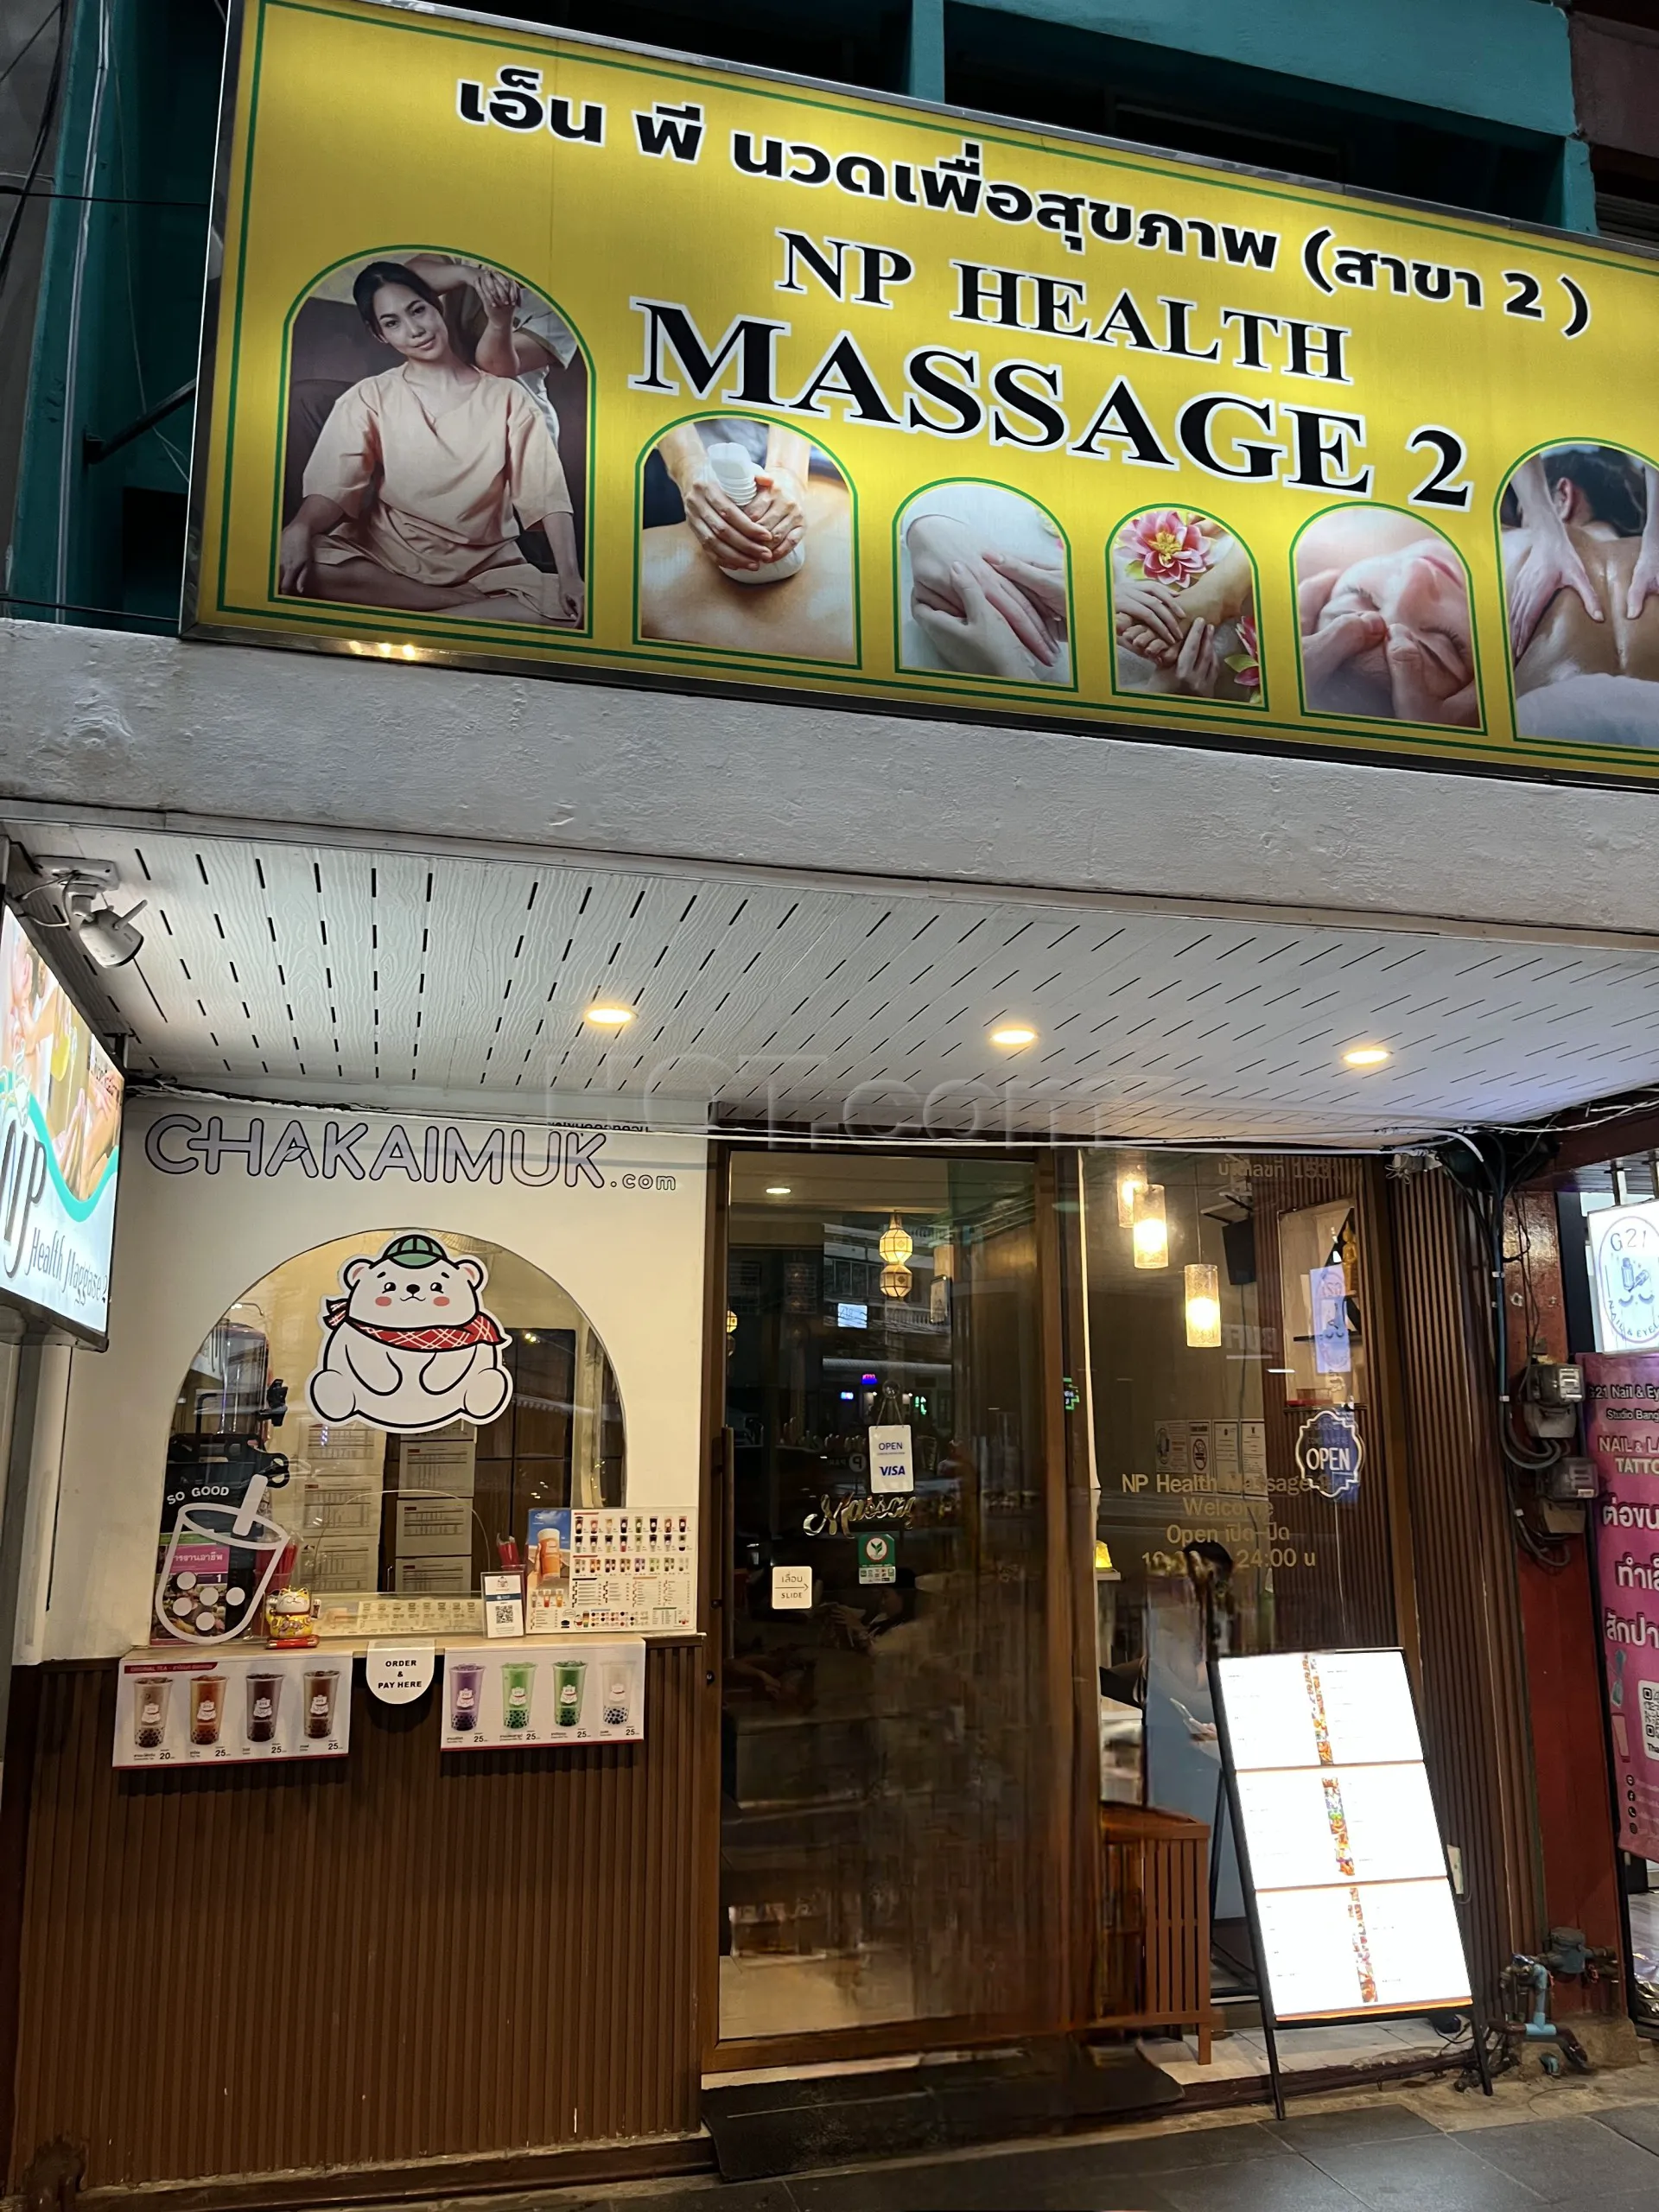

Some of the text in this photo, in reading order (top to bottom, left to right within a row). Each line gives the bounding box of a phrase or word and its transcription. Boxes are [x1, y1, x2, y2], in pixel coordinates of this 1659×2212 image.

[458, 67, 604, 144] เอ็น
[635, 104, 703, 162] พี
[732, 141, 1278, 269] นวดเพื่อสุขภาพ
[1304, 227, 1483, 308] (สาขา
[775, 228, 1352, 385] NP HEALTH
[629, 296, 1472, 512] MASSAGE 2
[1610, 1227, 1648, 1252] G21
[24, 1226, 66, 1281] Health
[1611, 1386, 1632, 1399] Nail
[1636, 1387, 1646, 1398] &
[878, 1441, 903, 1451] OPEN
[1599, 1438, 1631, 1452] NAIL
[1636, 1444, 1643, 1452] &
[1306, 1448, 1351, 1471] OPEN
[879, 1465, 906, 1476] VISA
[1122, 1473, 1149, 1493] NP
[1156, 1472, 1217, 1494] Health
[167, 1485, 230, 1505] SO GOOD
[1166, 1524, 1218, 1548] Open
[385, 1659, 417, 1668] ORDER
[397, 1680, 423, 1688] HERE
[215, 1749, 226, 1758] 25
[270, 1745, 282, 1754] 25
[327, 1742, 339, 1751] 25
[159, 1751, 171, 1760] 20
